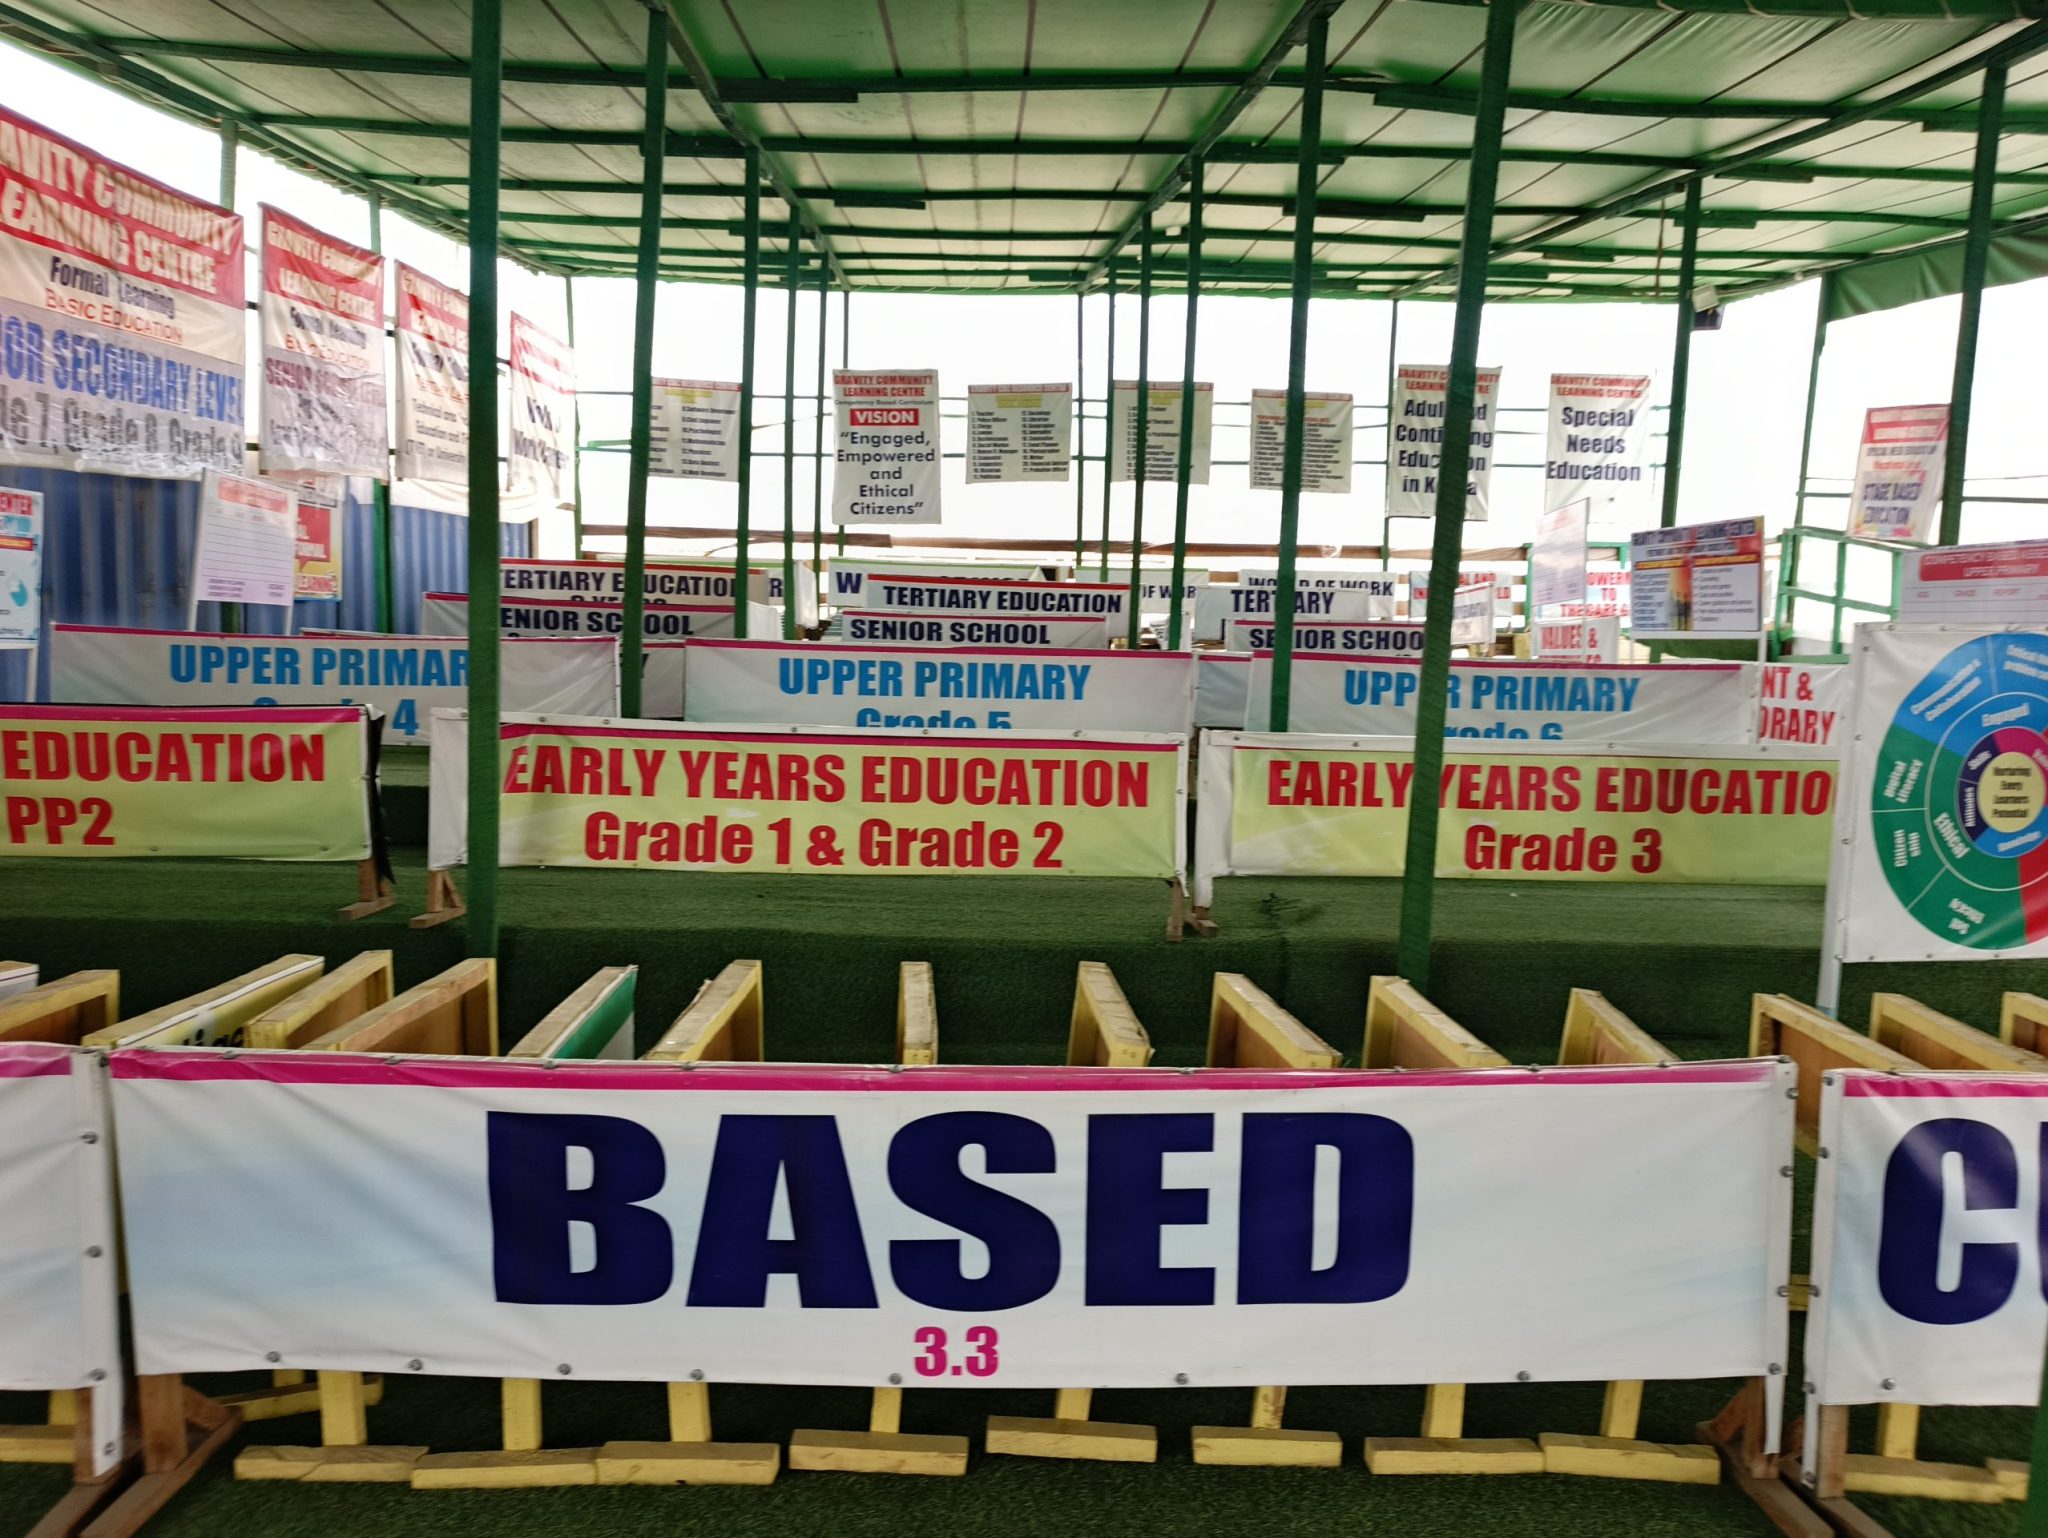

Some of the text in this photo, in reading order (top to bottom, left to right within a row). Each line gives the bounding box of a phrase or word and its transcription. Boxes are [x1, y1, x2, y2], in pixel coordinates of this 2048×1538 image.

[50, 256, 110, 298] Formal
[133, 230, 217, 295] CENTRE
[100, 304, 183, 343] EDUCATION
[52, 329, 191, 414] SECONDARY
[834, 375, 933, 385] GRAVITY COMMUNITY
[843, 387, 926, 397] LEARNING CENTRE
[1404, 399, 1444, 417] Adul
[855, 411, 914, 424] VISION
[1562, 406, 1634, 427] Special
[837, 449, 935, 465] Empowered
[1566, 434, 1626, 453] Needs
[870, 466, 902, 480] and
[1402, 476, 1419, 492] in
[1547, 461, 1641, 481] Education
[859, 484, 914, 497] Ethical
[503, 569, 606, 592] ERTIARY
[883, 586, 1122, 613] TERTIARY EDUCATION
[500, 607, 694, 636] ENIOR SCOOL
[851, 618, 1050, 645] SENIOR SCHOOL
[1250, 628, 1424, 650] SEIOR SCHOO
[170, 644, 469, 687] UPPER PRIMAR
[778, 657, 1092, 701] UPPER PRIMARY
[1344, 669, 1641, 712] UPPR PRIMARY
[1796, 671, 1814, 701] &
[391, 698, 418, 736] 4
[2, 729, 325, 783] EDUCATION
[502, 745, 1149, 808] EARLY YEARS EDUCATION
[1267, 760, 1834, 816] EARLY YEARS EDUCATIO
[6, 796, 115, 846] PP2
[1933, 812, 1971, 859] Ethical
[584, 811, 1064, 868] Grade 1 & Grade 2
[1463, 823, 1663, 875] Grade 3
[486, 1109, 1416, 1313] BASED
[912, 1326, 1000, 1379] 3.3
